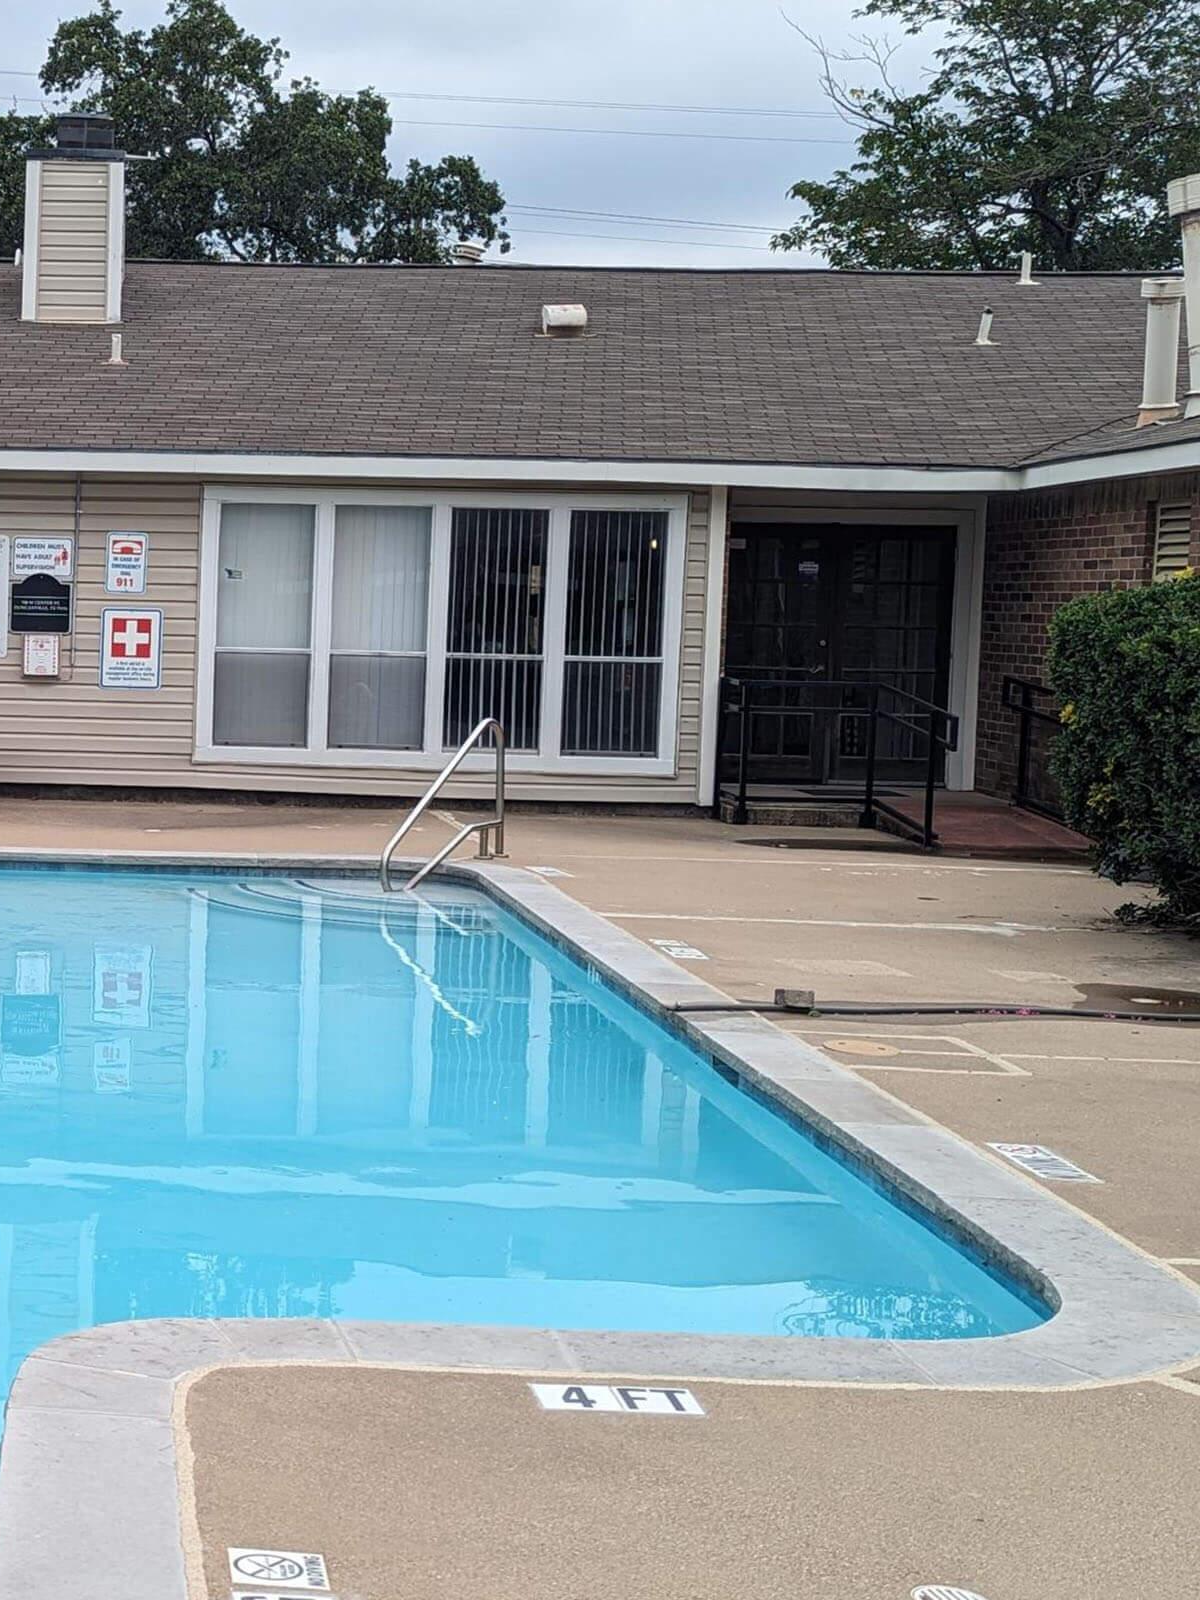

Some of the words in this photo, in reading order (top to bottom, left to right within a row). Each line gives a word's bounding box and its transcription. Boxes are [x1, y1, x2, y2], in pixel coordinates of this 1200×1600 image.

[115, 577, 134, 588] 911
[562, 1386, 597, 1409] 4
[616, 1387, 687, 1412] FT
